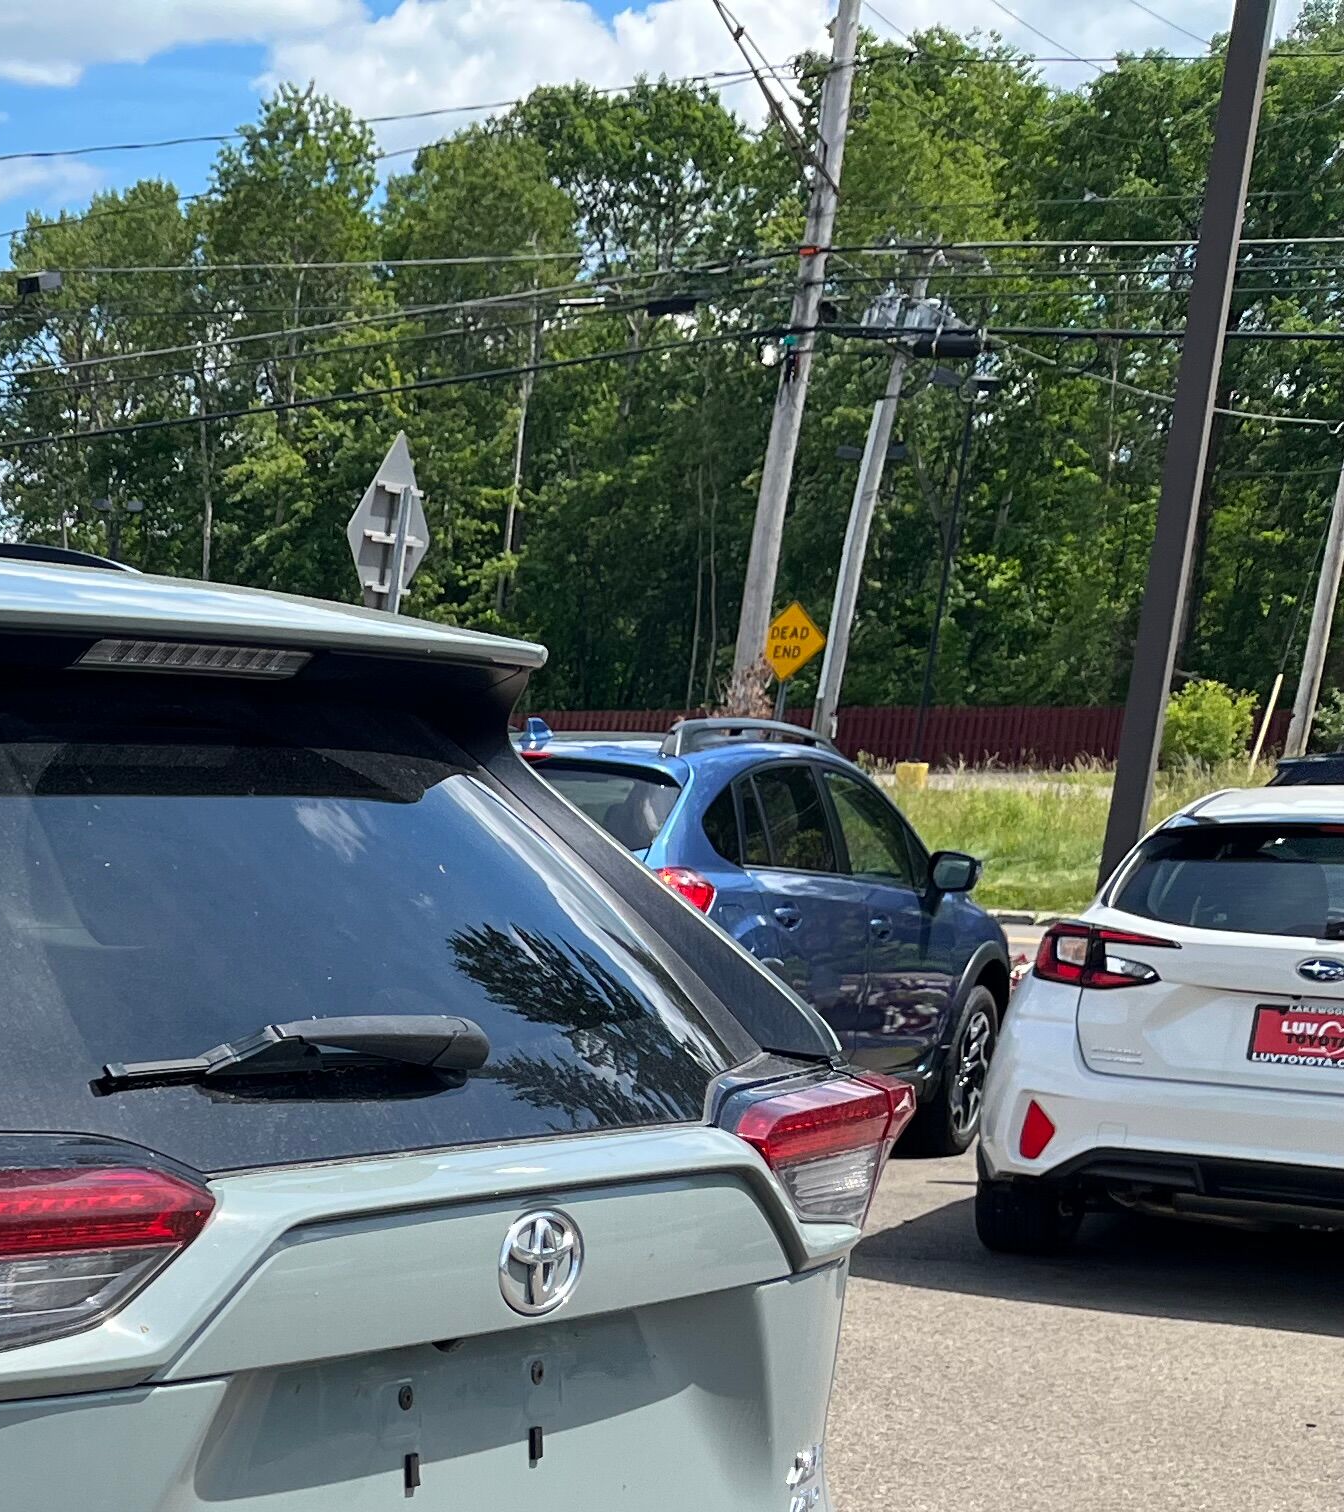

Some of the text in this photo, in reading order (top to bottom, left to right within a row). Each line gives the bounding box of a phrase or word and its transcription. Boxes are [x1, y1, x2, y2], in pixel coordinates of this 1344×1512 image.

[770, 625, 810, 641] DEAD
[773, 645, 801, 660] END
[1289, 1004, 1344, 1016] LAKEWOO
[1281, 1020, 1319, 1035] LUV
